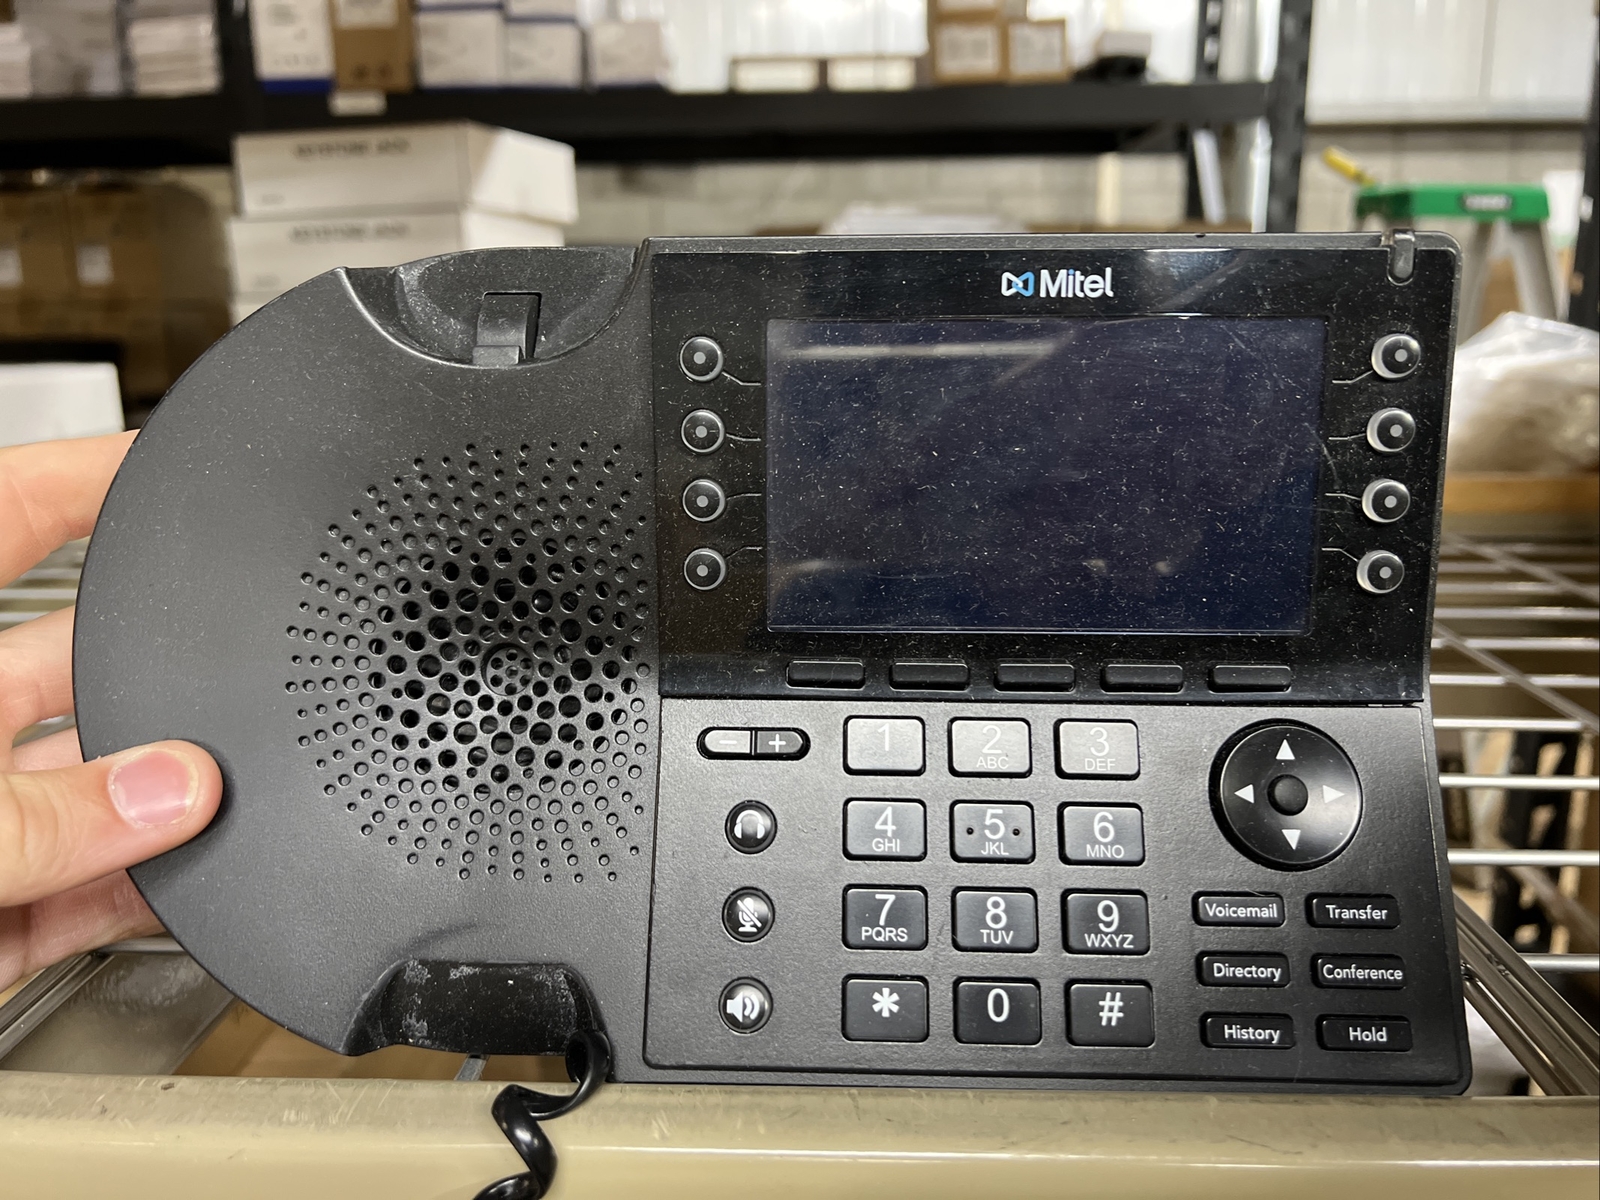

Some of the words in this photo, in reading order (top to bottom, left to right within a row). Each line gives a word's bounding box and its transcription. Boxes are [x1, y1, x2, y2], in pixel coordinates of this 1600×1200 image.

[1040, 267, 1114, 298] Mitel
[877, 723, 890, 752] 1
[981, 725, 1002, 754] 2
[1089, 727, 1110, 756] 3
[976, 756, 1009, 770] ABC
[1084, 758, 1116, 771] DEF
[874, 806, 897, 838] 4
[985, 809, 1005, 840] 5
[1092, 811, 1115, 843] 6
[872, 838, 901, 853] GHI
[980, 842, 1010, 856] JKL
[1086, 844, 1124, 859] MNO
[874, 894, 896, 926] 7
[985, 896, 1008, 929] 8
[1097, 900, 1120, 932] 9
[1205, 903, 1278, 919] Voicemail
[1325, 904, 1388, 920] Transfer
[861, 927, 909, 943] PQRS
[979, 929, 1013, 945] TUV
[1084, 934, 1135, 949] WXYZ
[1213, 963, 1282, 982] Directory
[1322, 964, 1404, 981] Conference
[987, 991, 1010, 1022] 0
[1224, 1025, 1281, 1044] History
[1348, 1027, 1388, 1043] Hold
